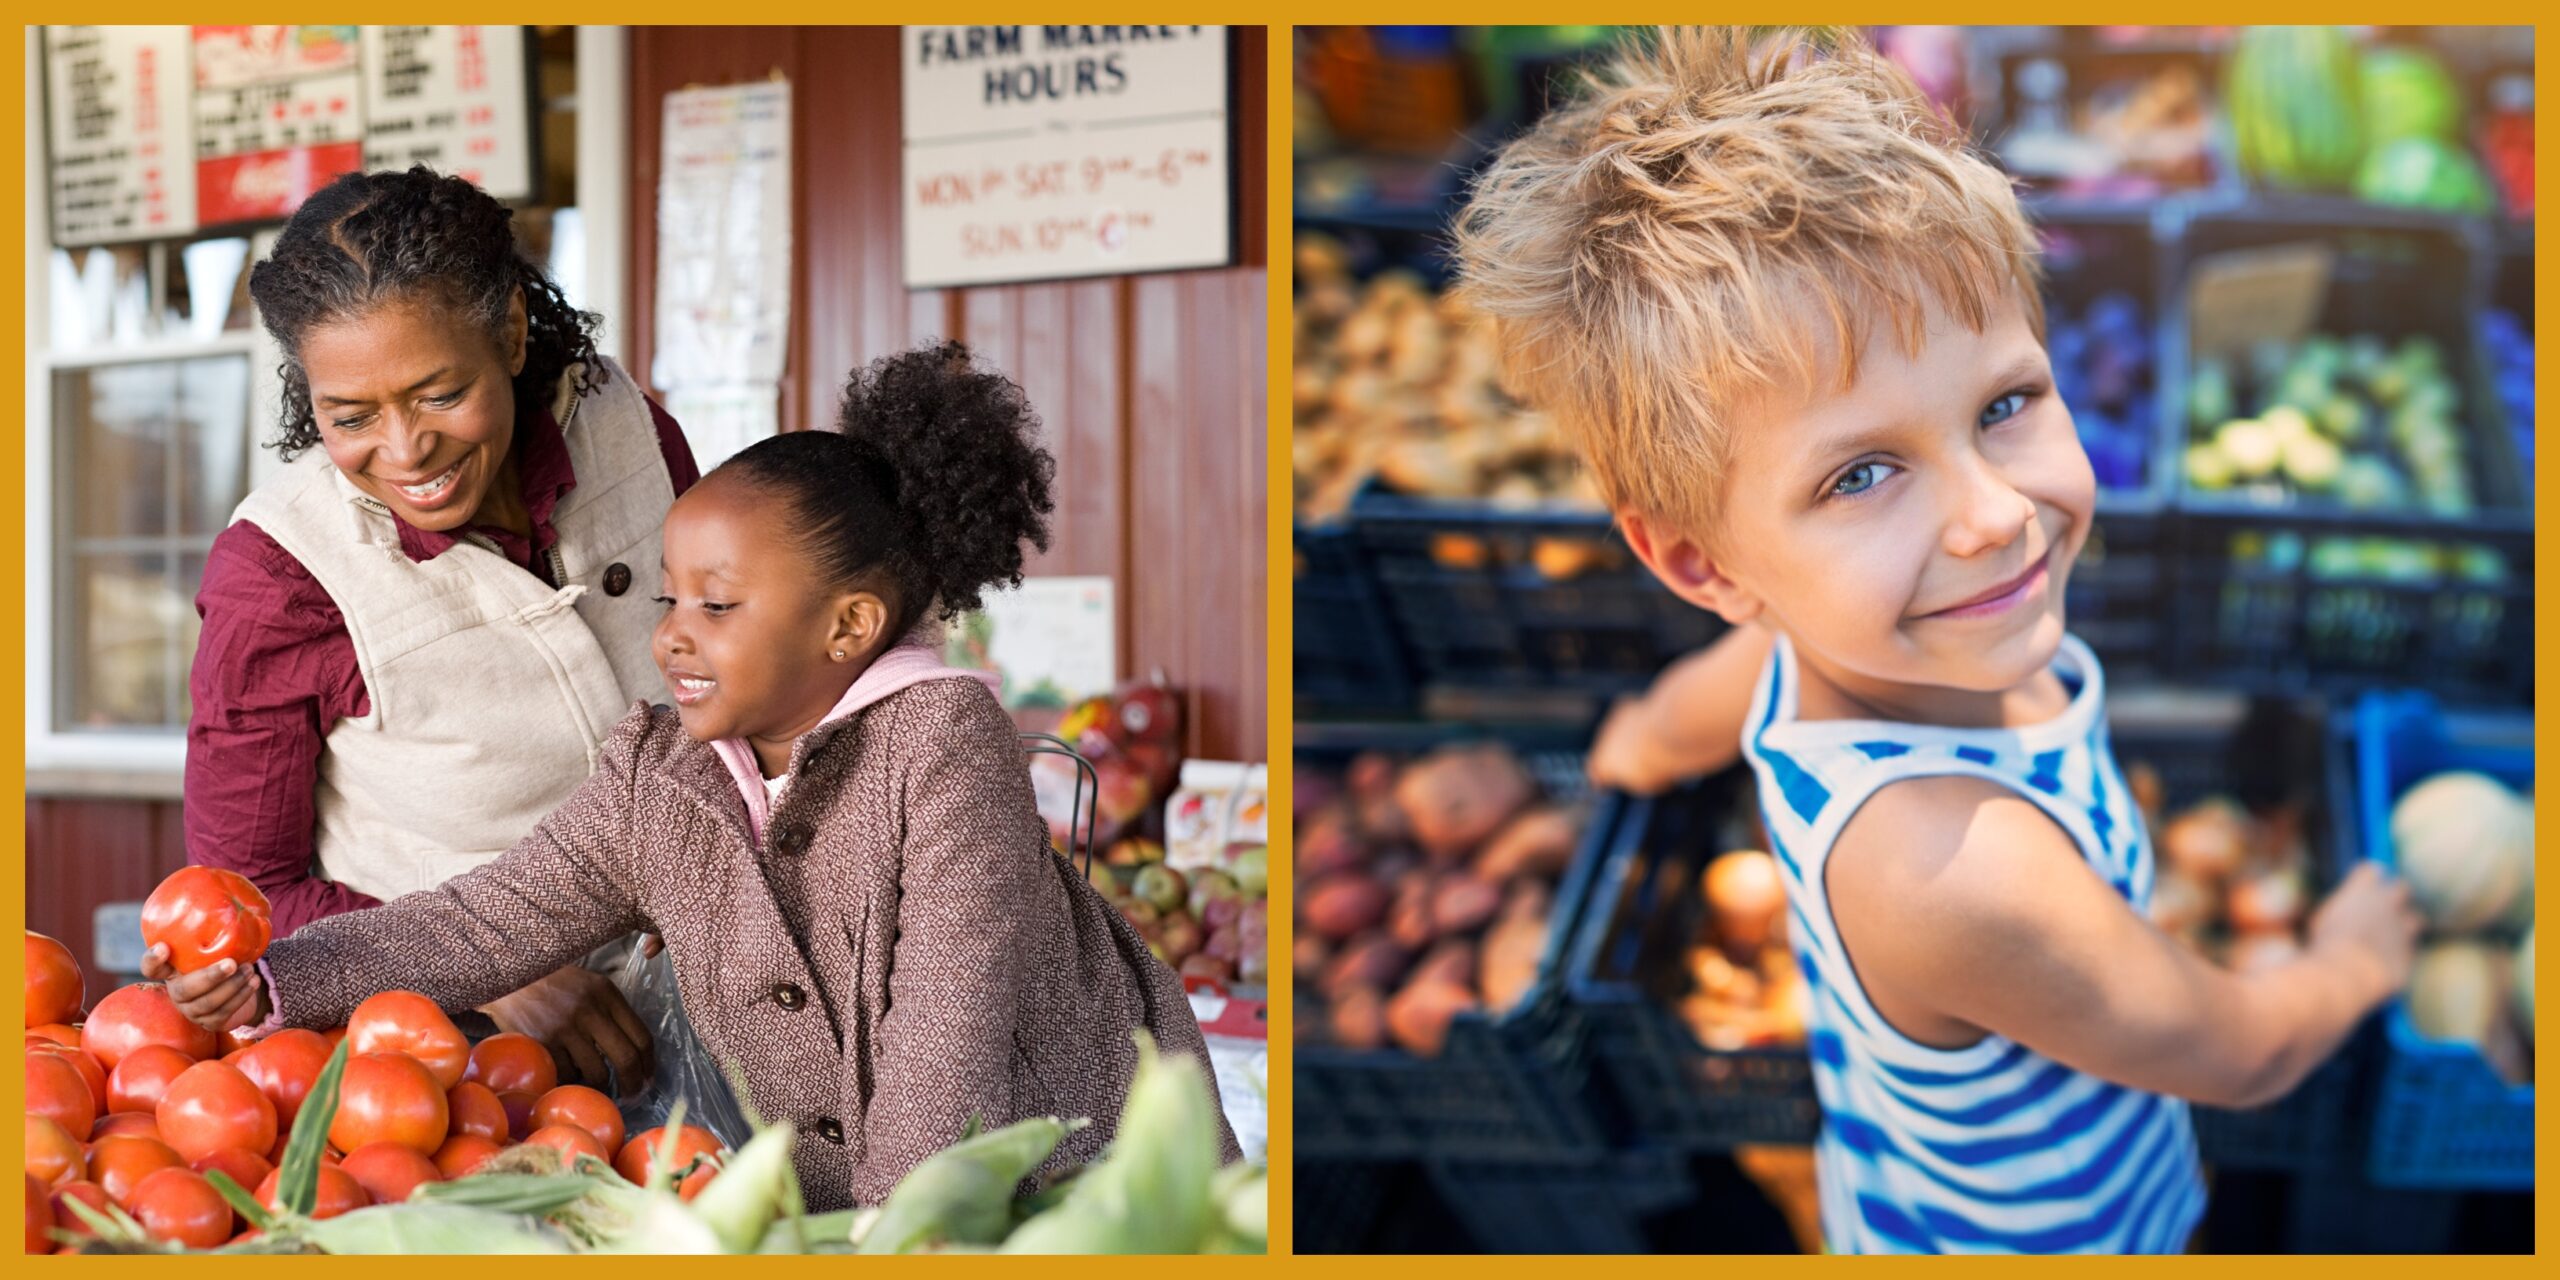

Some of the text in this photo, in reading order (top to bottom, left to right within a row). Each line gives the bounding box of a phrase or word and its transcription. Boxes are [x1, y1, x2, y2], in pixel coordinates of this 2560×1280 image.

[919, 25, 1207, 66] FARM MAR
[983, 52, 1127, 104] HOURS
[916, 173, 974, 207] MON
[961, 224, 1023, 257] SUN
